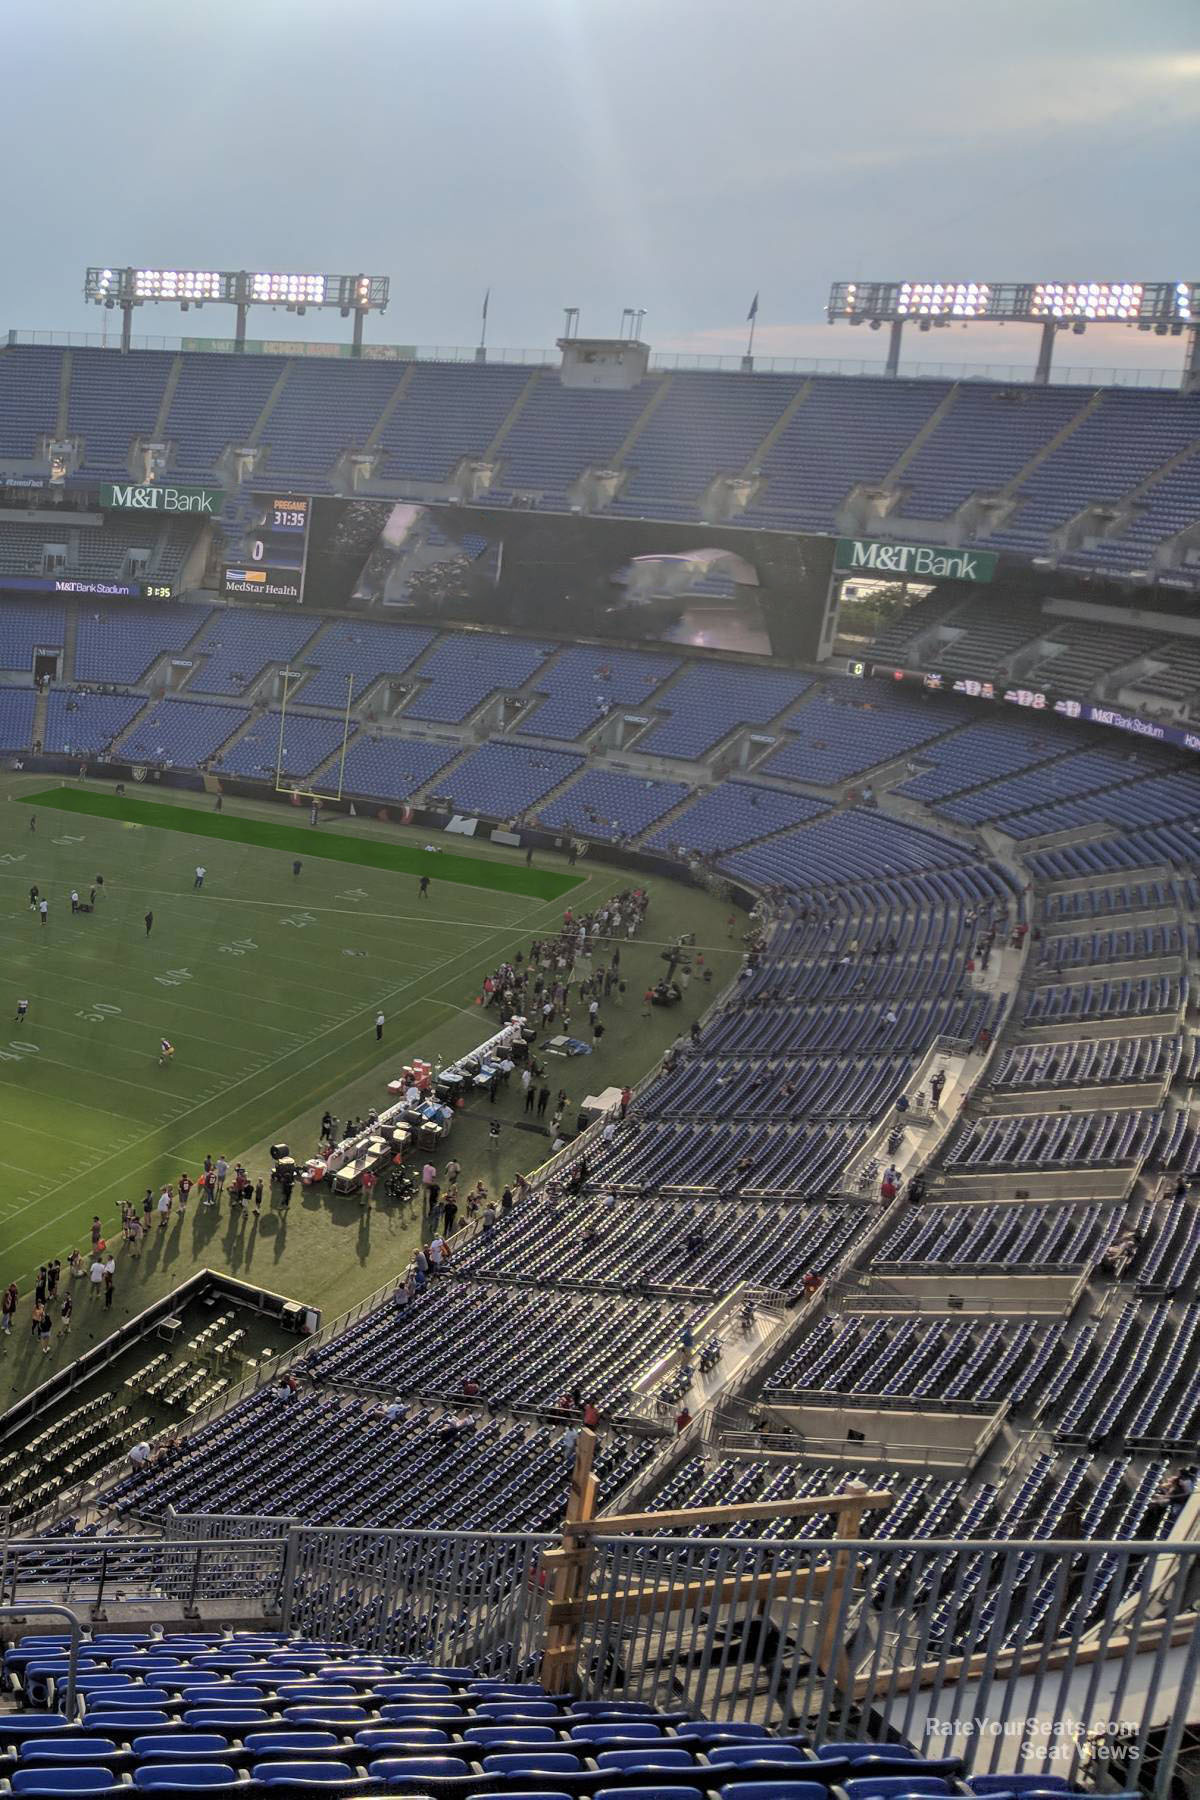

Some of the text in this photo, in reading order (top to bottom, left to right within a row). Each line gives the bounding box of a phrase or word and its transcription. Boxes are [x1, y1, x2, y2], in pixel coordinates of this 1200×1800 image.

[111, 485, 213, 512] M&T Bank
[273, 500, 307, 511] PREGAME
[274, 511, 305, 526] 31:35
[252, 540, 264, 561] 0
[851, 541, 977, 579] M&T Bank
[55, 581, 129, 595] M&T Bank Stadium
[225, 581, 298, 596] MedStar Health
[1091, 708, 1164, 738] M&T Bank Stadium
[153, 968, 194, 987] 40
[75, 1003, 122, 1023] 50
